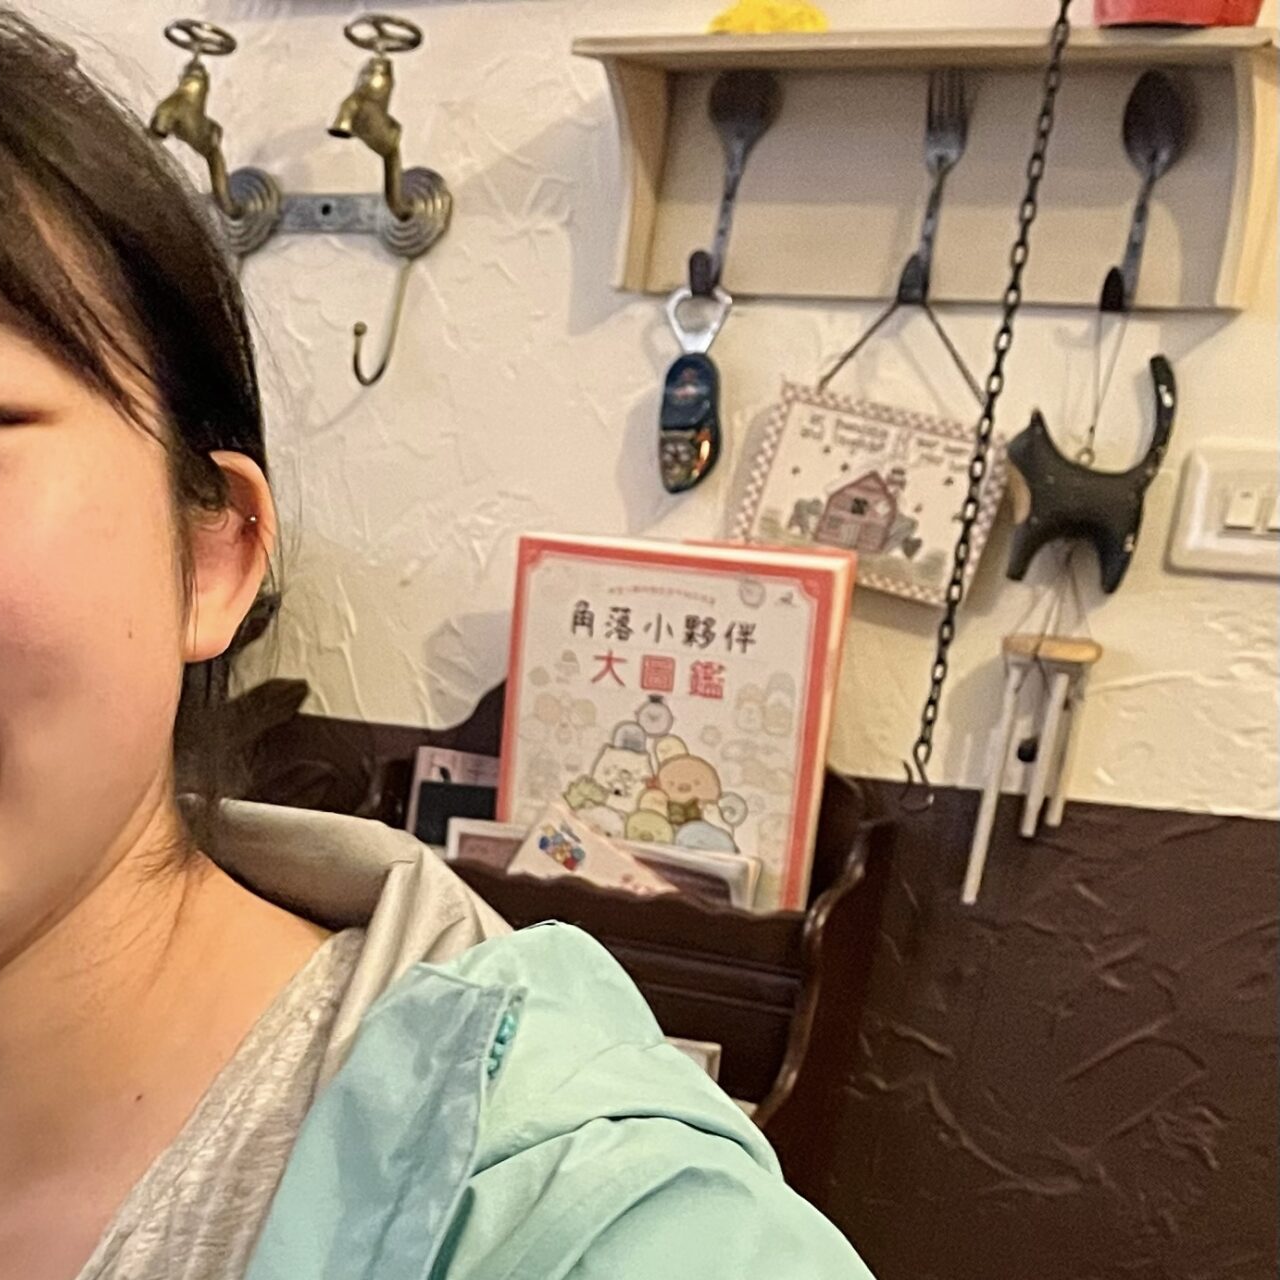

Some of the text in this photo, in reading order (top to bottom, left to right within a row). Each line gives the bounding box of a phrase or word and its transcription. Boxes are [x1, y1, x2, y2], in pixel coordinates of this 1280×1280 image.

[571, 600, 757, 654] 角落小夥伴
[591, 649, 727, 700] 大圖鑑
